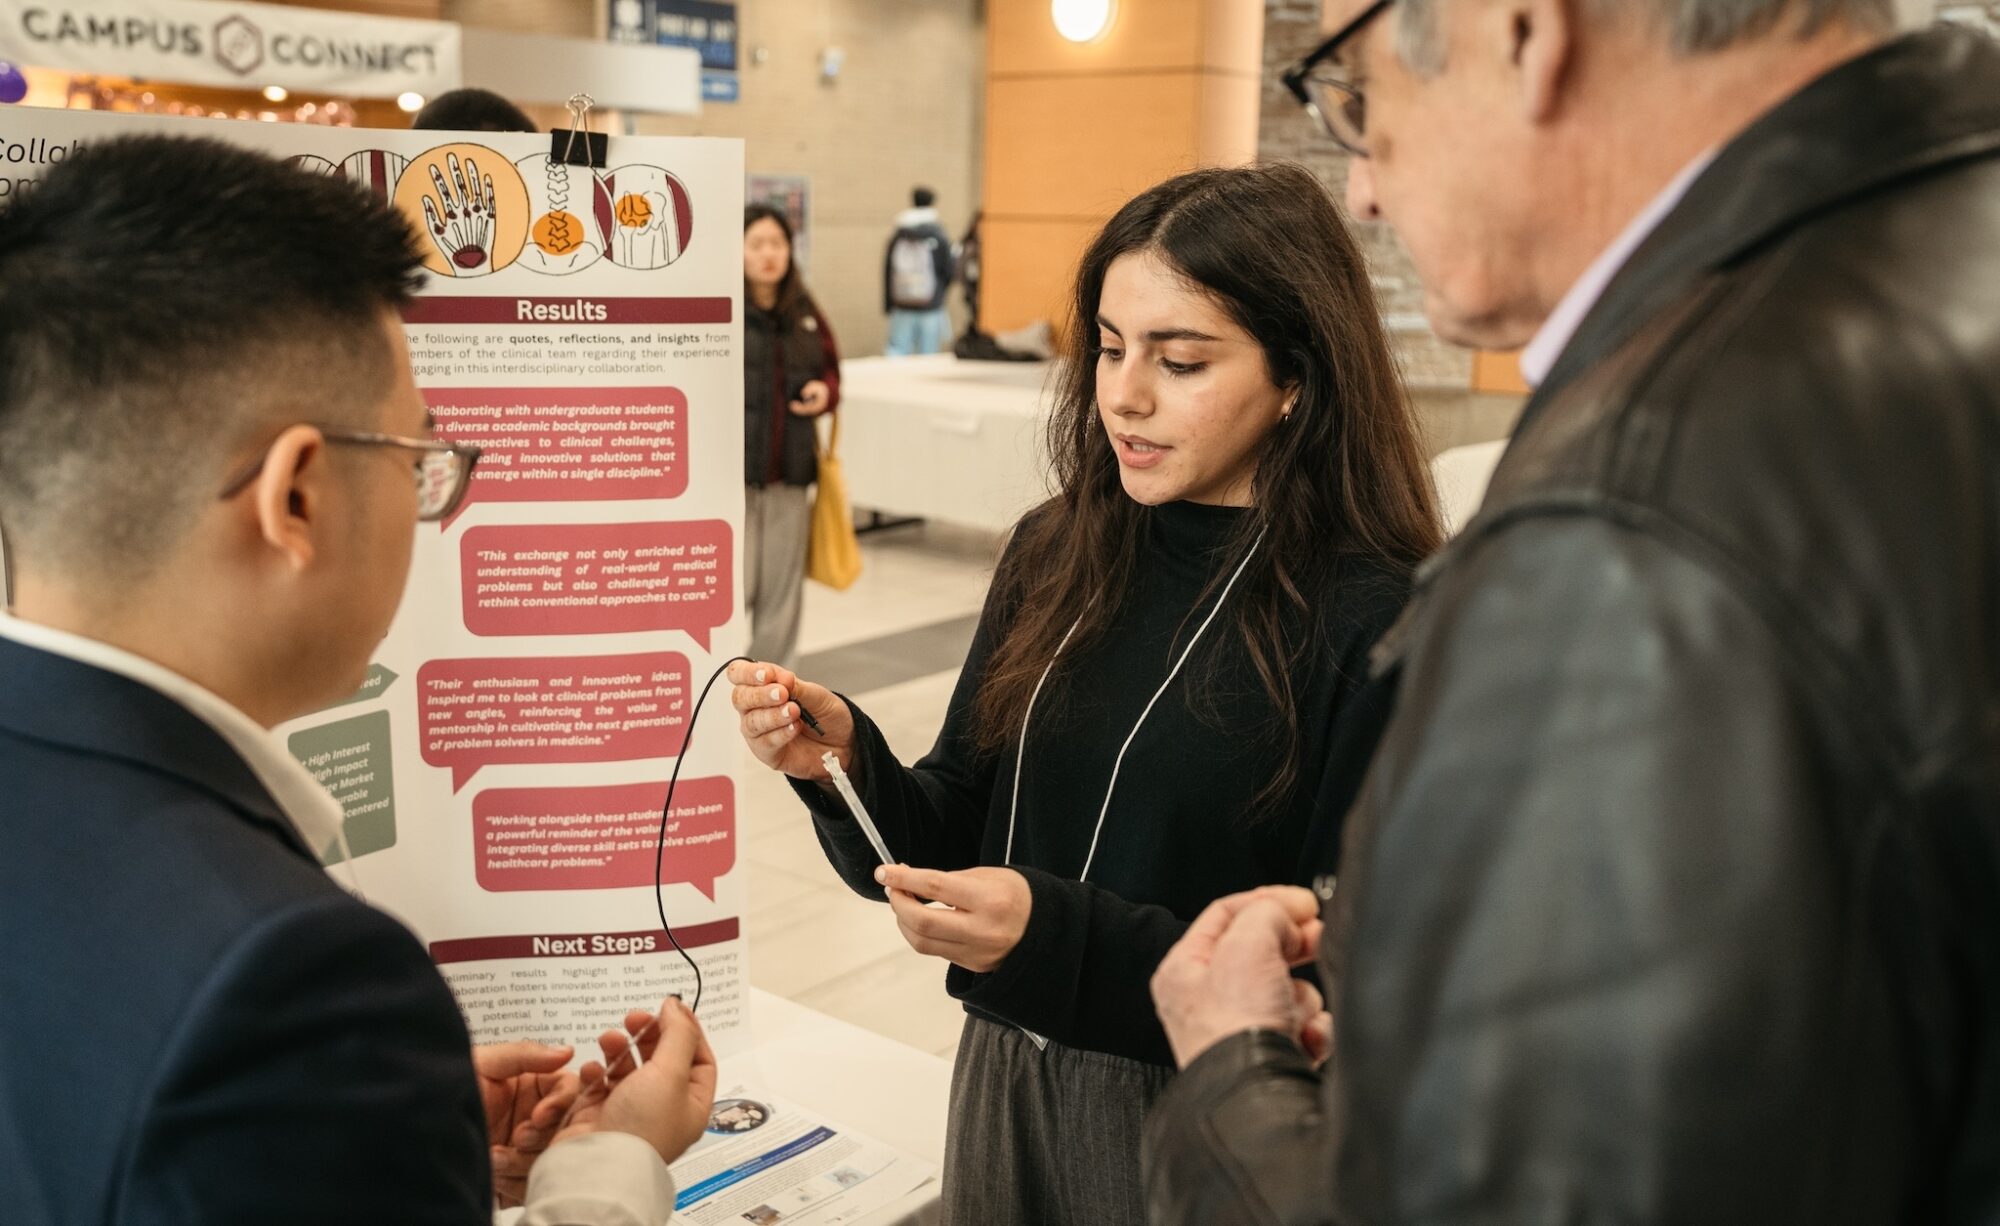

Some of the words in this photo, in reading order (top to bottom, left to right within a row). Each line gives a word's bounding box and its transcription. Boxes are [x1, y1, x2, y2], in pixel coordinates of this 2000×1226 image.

[21, 8, 202, 56] CAMPUS
[271, 34, 437, 73] CONNECT
[517, 300, 607, 321] Results
[404, 333, 419, 344] he
[425, 333, 479, 346] following
[485, 335, 503, 344] are
[509, 335, 553, 346] quotes,
[559, 333, 624, 345] reflections,
[630, 333, 651, 344] and
[657, 333, 700, 345] insights
[706, 333, 730, 343] from
[409, 349, 453, 359] embers
[459, 349, 471, 359] of
[476, 349, 496, 359] the
[502, 349, 542, 359] clinical
[547, 350, 576, 359] team
[582, 349, 636, 360] regarding
[641, 349, 667, 359] their
[673, 348, 730, 360] experience
[454, 364, 464, 374] in
[468, 364, 488, 374] this
[492, 363, 585, 375] interdisciplinary
[588, 363, 665, 374] collaboration.
[425, 405, 502, 418] ollaborating
[505, 405, 531, 416] with
[534, 405, 621, 417] undergraduate
[624, 404, 675, 415] students
[446, 420, 489, 433] diverse
[492, 420, 549, 432] academic
[552, 420, 627, 433] backgrounds
[630, 420, 675, 432] brought
[539, 437, 551, 447] to
[560, 436, 602, 447] clinical
[611, 436, 675, 449] challenges,
[520, 452, 582, 463] innovative
[590, 452, 643, 463] solutions
[651, 452, 676, 462] that
[476, 470, 519, 482] emerge
[522, 469, 558, 480] within
[560, 470, 568, 479] a
[570, 468, 604, 481] single
[514, 550, 568, 562] exchange
[576, 550, 596, 560] not
[603, 549, 628, 560] only
[635, 546, 684, 557] enriched
[690, 544, 717, 555] their
[477, 565, 562, 578] understanding
[575, 565, 589, 575] of
[601, 562, 660, 574] real-world
[673, 560, 717, 571] medical
[477, 582, 533, 594] problems
[543, 581, 563, 591] but
[573, 580, 597, 591] also
[608, 577, 669, 590] challenged
[678, 576, 695, 586] me
[705, 575, 717, 585] to
[479, 597, 519, 608] rethink
[522, 595, 597, 607] conventional
[599, 593, 665, 607] approaches
[669, 593, 680, 602] to
[473, 677, 539, 689] enthusiasm
[549, 676, 571, 687] and
[582, 674, 642, 686] innovative
[651, 671, 681, 682] ideas
[427, 694, 474, 707] inspired
[477, 694, 494, 704] me
[498, 693, 510, 703] to
[513, 692, 538, 702] look
[541, 692, 554, 702] at
[556, 690, 598, 701] clinical
[600, 689, 652, 702] problems
[655, 685, 681, 696] from
[428, 711, 452, 720] new
[465, 708, 507, 721] angles,
[520, 706, 582, 719] reinforcing
[595, 705, 614, 715] the
[627, 702, 657, 713] value
[670, 700, 683, 711] of
[429, 724, 495, 737] mentorship
[497, 723, 508, 732] in
[511, 721, 572, 733] cultivating
[575, 720, 593, 730] the
[596, 719, 620, 730] next
[622, 715, 682, 730] generation
[430, 740, 443, 751] of
[444, 738, 493, 752] problem
[494, 737, 535, 748] solvers
[537, 736, 547, 746] in
[308, 752, 330, 767] High
[333, 742, 371, 759] Interest
[334, 758, 368, 775] Impact
[339, 772, 374, 788] Market
[539, 814, 592, 826] alongside
[594, 812, 625, 823] these
[627, 809, 675, 822] studens
[676, 807, 696, 818] has
[698, 803, 723, 814] been
[486, 831, 494, 840] a
[496, 828, 546, 841] powerful
[547, 827, 598, 839] reminder
[600, 826, 615, 839] of
[615, 825, 633, 836] the
[635, 824, 665, 835] valu
[667, 822, 681, 834] of
[487, 843, 548, 856] integrating
[551, 842, 591, 853] diverse
[593, 840, 615, 852] skill
[617, 840, 639, 851] sets
[641, 839, 653, 849] to
[685, 831, 728, 845] complex
[487, 857, 548, 870] healthcare
[532, 937, 587, 954] Next
[591, 934, 656, 954] Steps
[511, 968, 547, 978] results
[562, 967, 608, 979] highlight
[624, 965, 645, 975] that
[510, 981, 547, 992] fosters
[551, 980, 607, 990] innovation
[610, 979, 621, 988] in
[624, 977, 641, 988] the
[645, 973, 698, 986] biomedica
[703, 969, 726, 979] field
[497, 996, 536, 1006] diverse
[540, 993, 597, 1006] knowledge
[600, 992, 620, 1003] and
[624, 990, 671, 1004] expertis
[482, 1009, 531, 1022] potential
[544, 1008, 559, 1018] for
[503, 1022, 549, 1034] curricula
[553, 1021, 573, 1032] and
[576, 1021, 588, 1031] as
